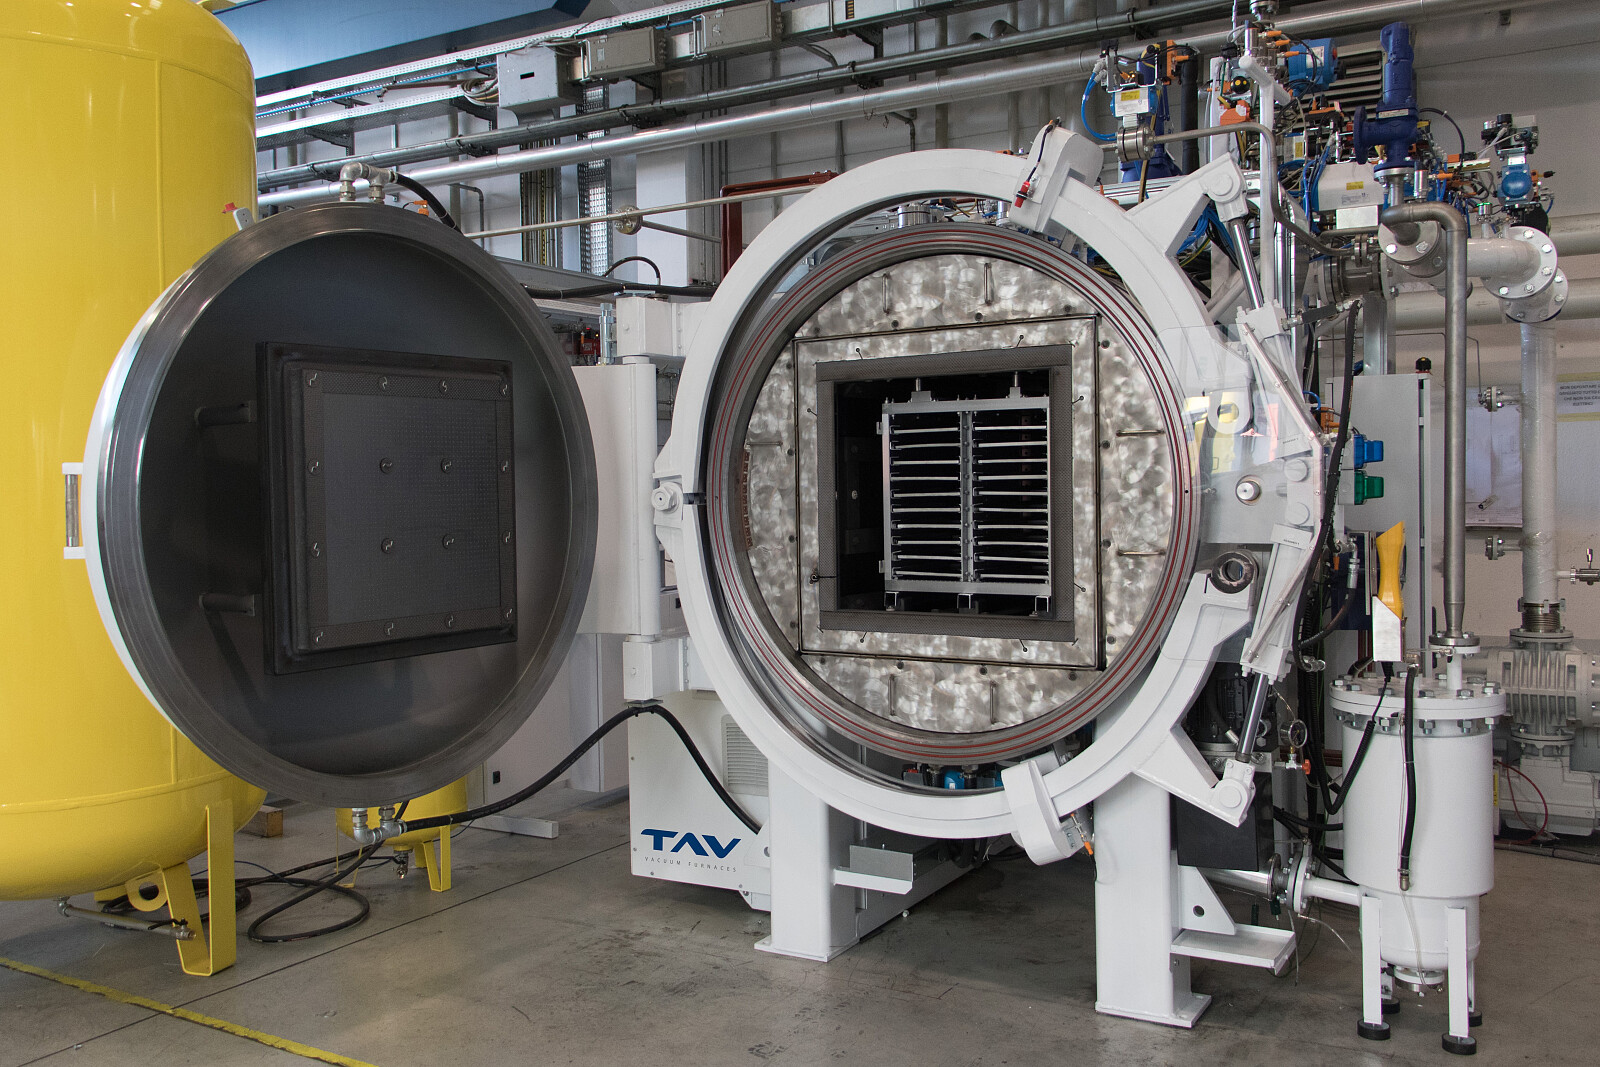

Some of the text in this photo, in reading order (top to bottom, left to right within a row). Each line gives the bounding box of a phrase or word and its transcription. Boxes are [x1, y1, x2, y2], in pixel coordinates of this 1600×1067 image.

[640, 828, 742, 859] TAV
[645, 856, 737, 872] VACUUM FURNACES
